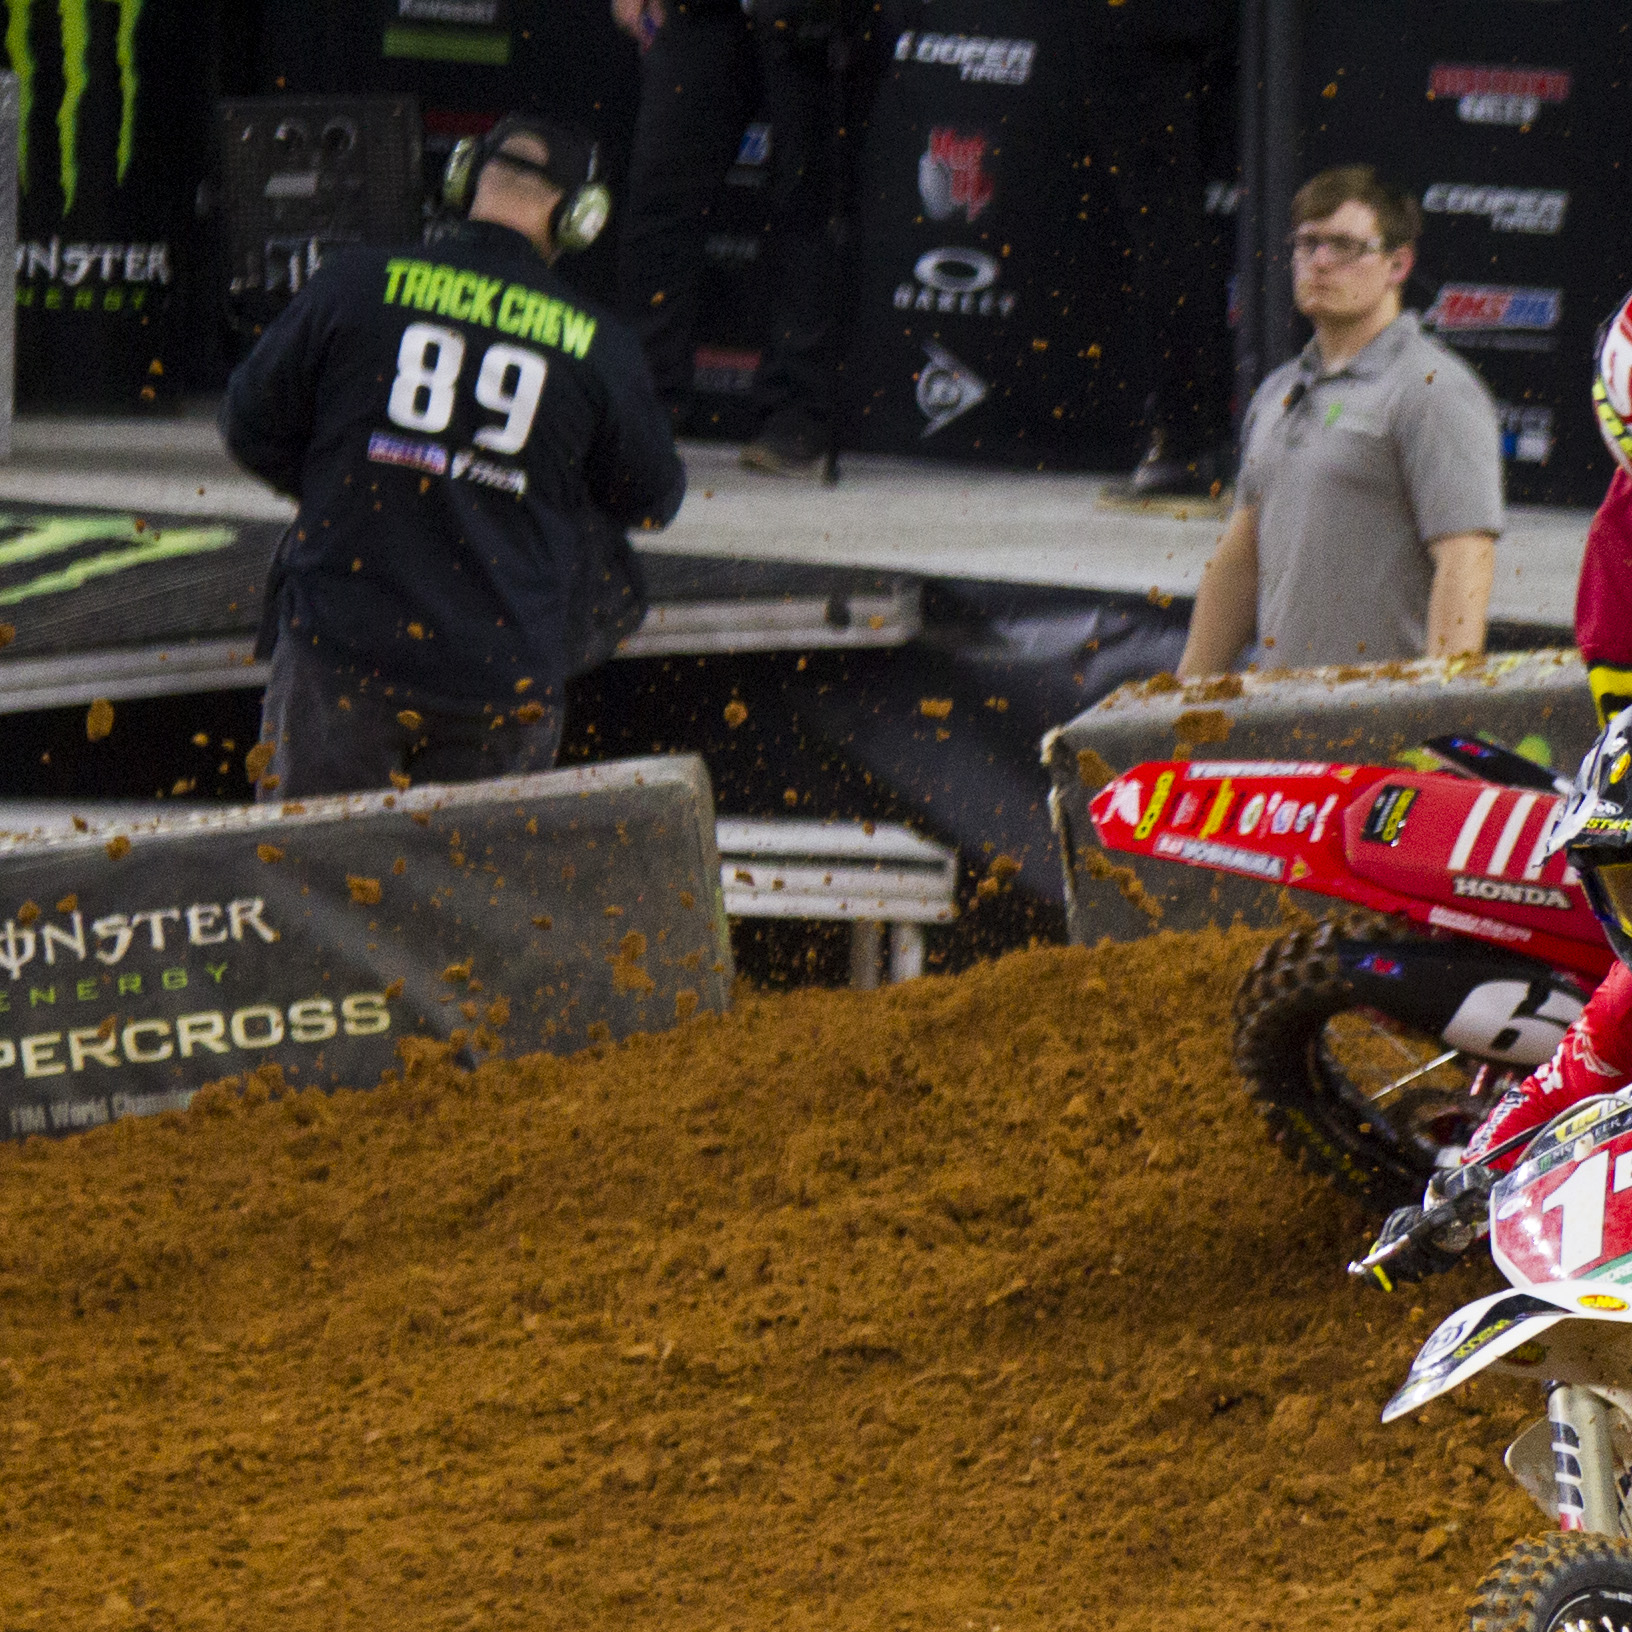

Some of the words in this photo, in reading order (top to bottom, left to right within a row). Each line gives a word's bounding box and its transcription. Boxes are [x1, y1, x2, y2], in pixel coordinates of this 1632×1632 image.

[16, 235, 171, 286] NSTER
[384, 257, 503, 328] TRACK
[497, 283, 598, 360] CREW
[387, 321, 549, 455] 89
[1453, 875, 1573, 910] HONDA
[0, 897, 277, 979] ONSTER
[0, 960, 230, 1007] NERGY
